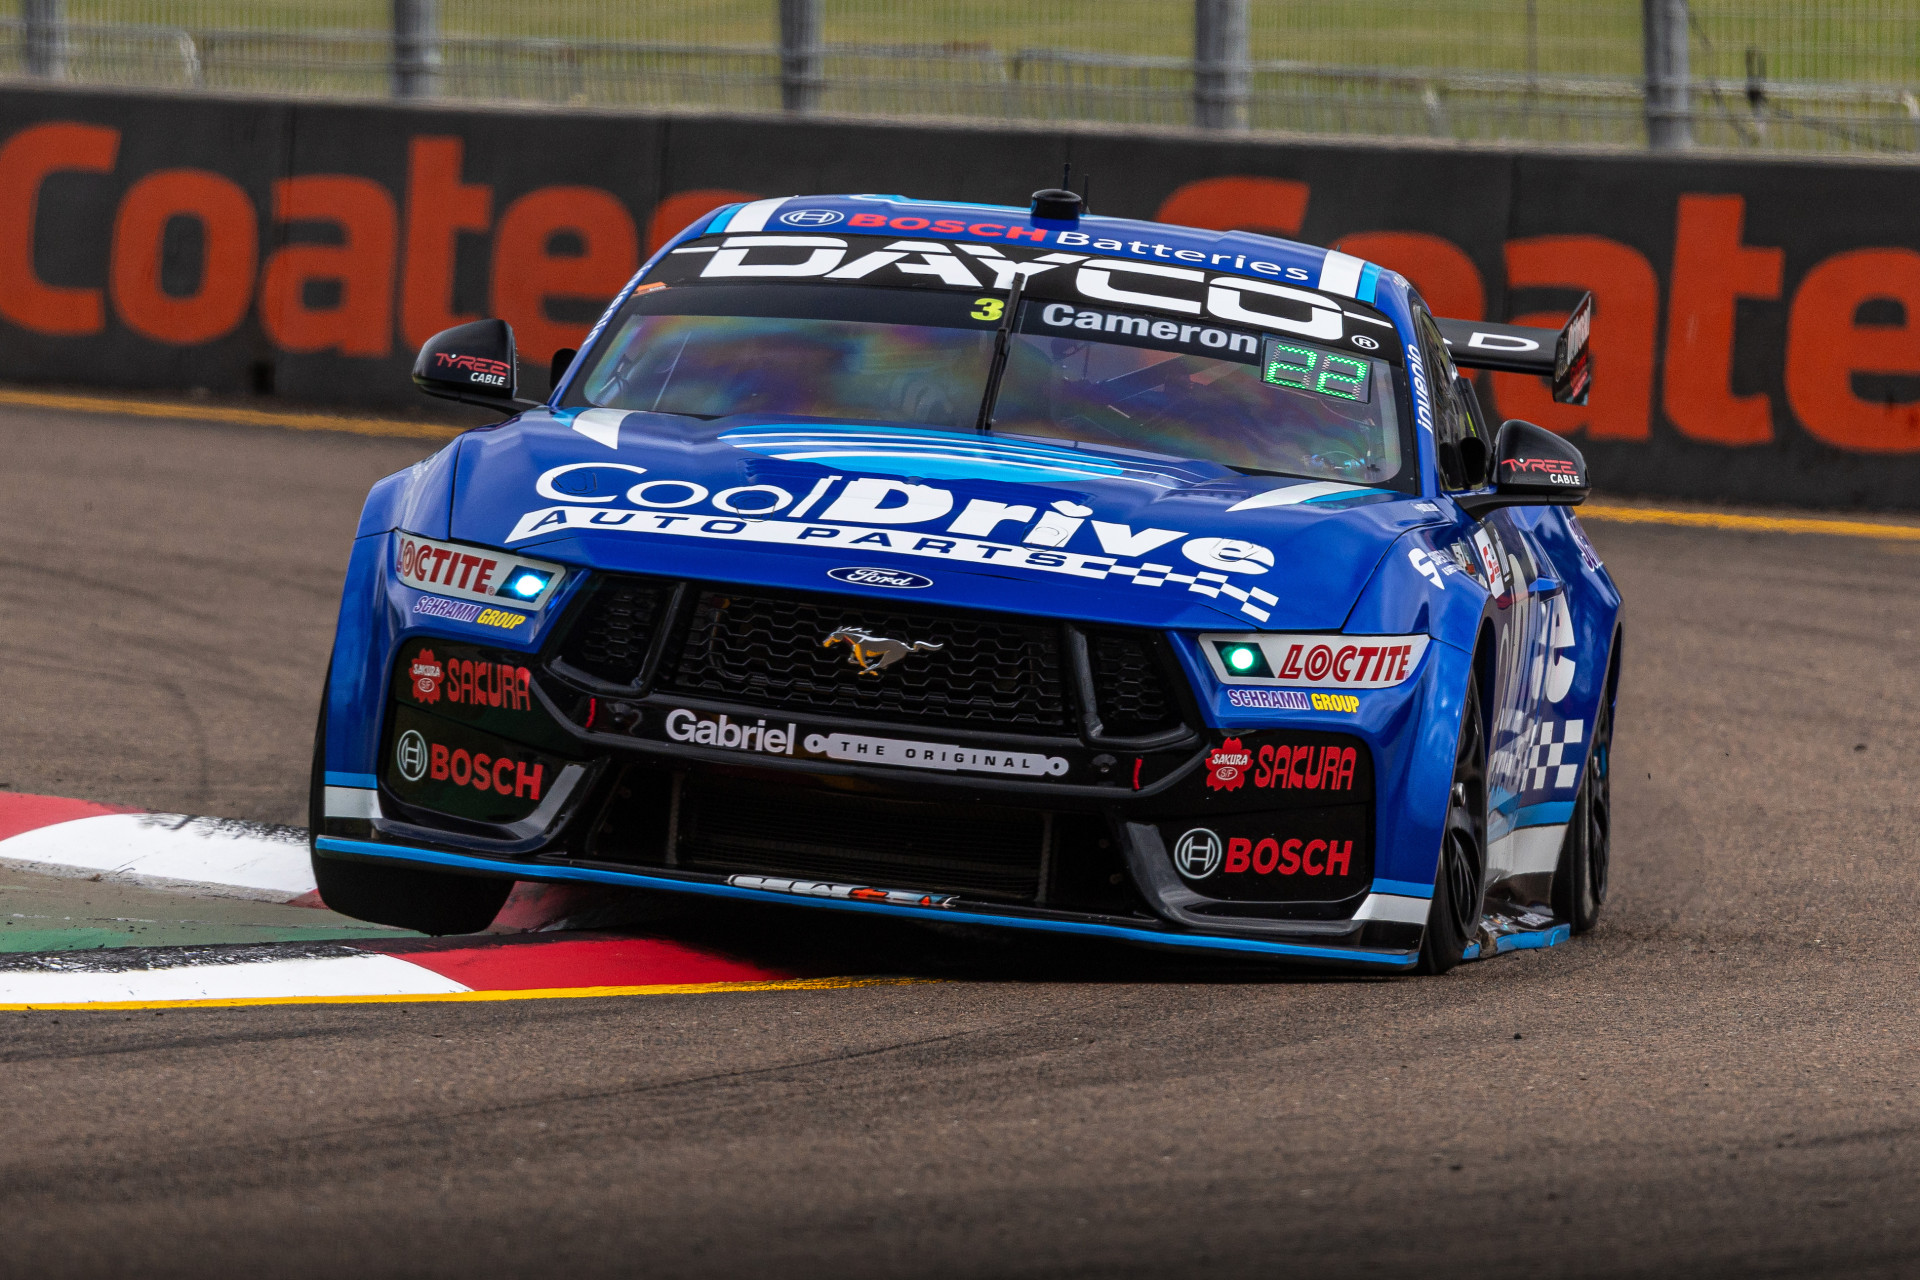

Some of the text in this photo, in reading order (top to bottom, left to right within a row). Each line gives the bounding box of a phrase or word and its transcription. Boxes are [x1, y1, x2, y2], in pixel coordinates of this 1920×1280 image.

[0, 121, 768, 367] Coate
[847, 212, 1309, 281] BOSCH Batteries
[699, 235, 1345, 341] DAYCO
[970, 297, 1005, 321] 3
[1042, 303, 1258, 355] Cameron
[435, 352, 511, 377] TYREE
[470, 371, 506, 386] CABLE
[1265, 344, 1368, 401] 22
[1407, 343, 1434, 435] invenio
[1501, 457, 1577, 475] TYREE
[1549, 472, 1581, 486] CABLE
[528, 509, 1068, 568] AUTO PARTS
[396, 537, 498, 594] LOCTITE
[845, 567, 914, 588] Ford
[413, 595, 527, 630] SCHRAMM GROUP
[413, 663, 441, 677] SAKURA
[1278, 643, 1412, 683] LOCTITE
[447, 658, 532, 712] SAKURA
[1227, 689, 1360, 713] SCHRAMM GROUP
[664, 708, 1032, 770] Gabriel THE ORIGINAL
[1212, 753, 1249, 766] SAKURA
[430, 743, 544, 801] BOSCH
[1254, 744, 1357, 791] SAKURA
[1224, 837, 1353, 876] BOSCH
